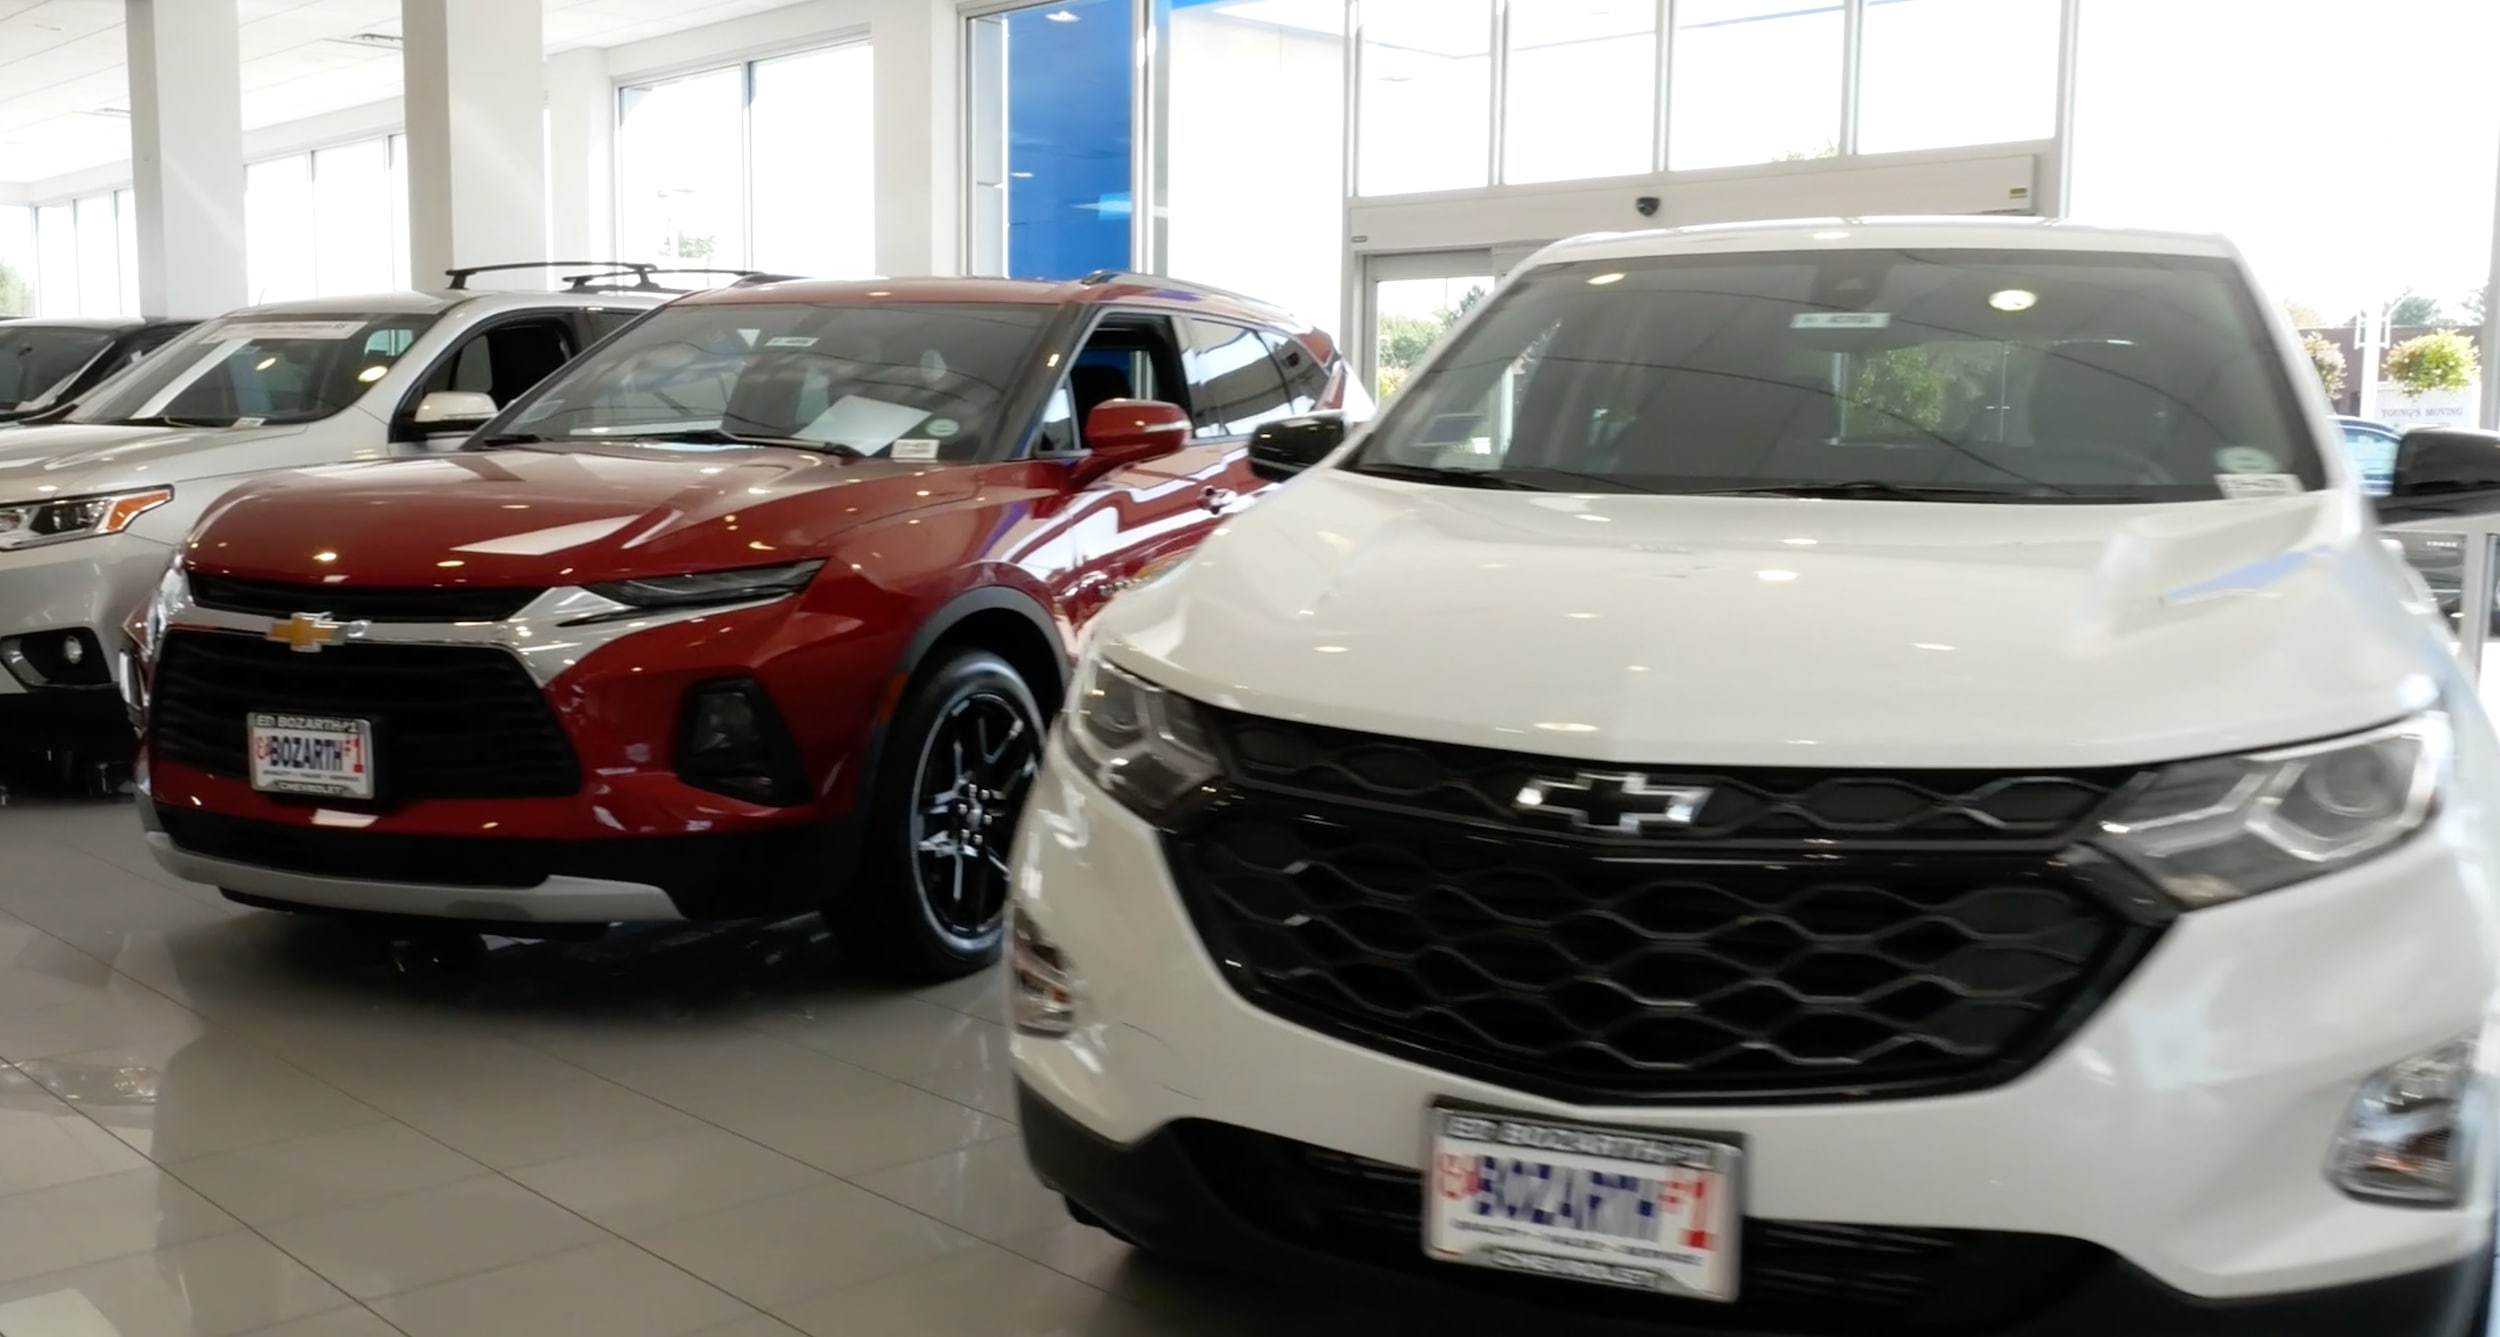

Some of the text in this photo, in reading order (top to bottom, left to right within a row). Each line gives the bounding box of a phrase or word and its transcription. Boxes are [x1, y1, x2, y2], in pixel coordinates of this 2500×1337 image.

[2425, 407, 2463, 416] MOVING
[257, 715, 275, 727] ED
[278, 717, 340, 731] BOZARTH
[271, 735, 343, 772] BOZARTH
[1475, 1155, 1659, 1244] BOZARTH
